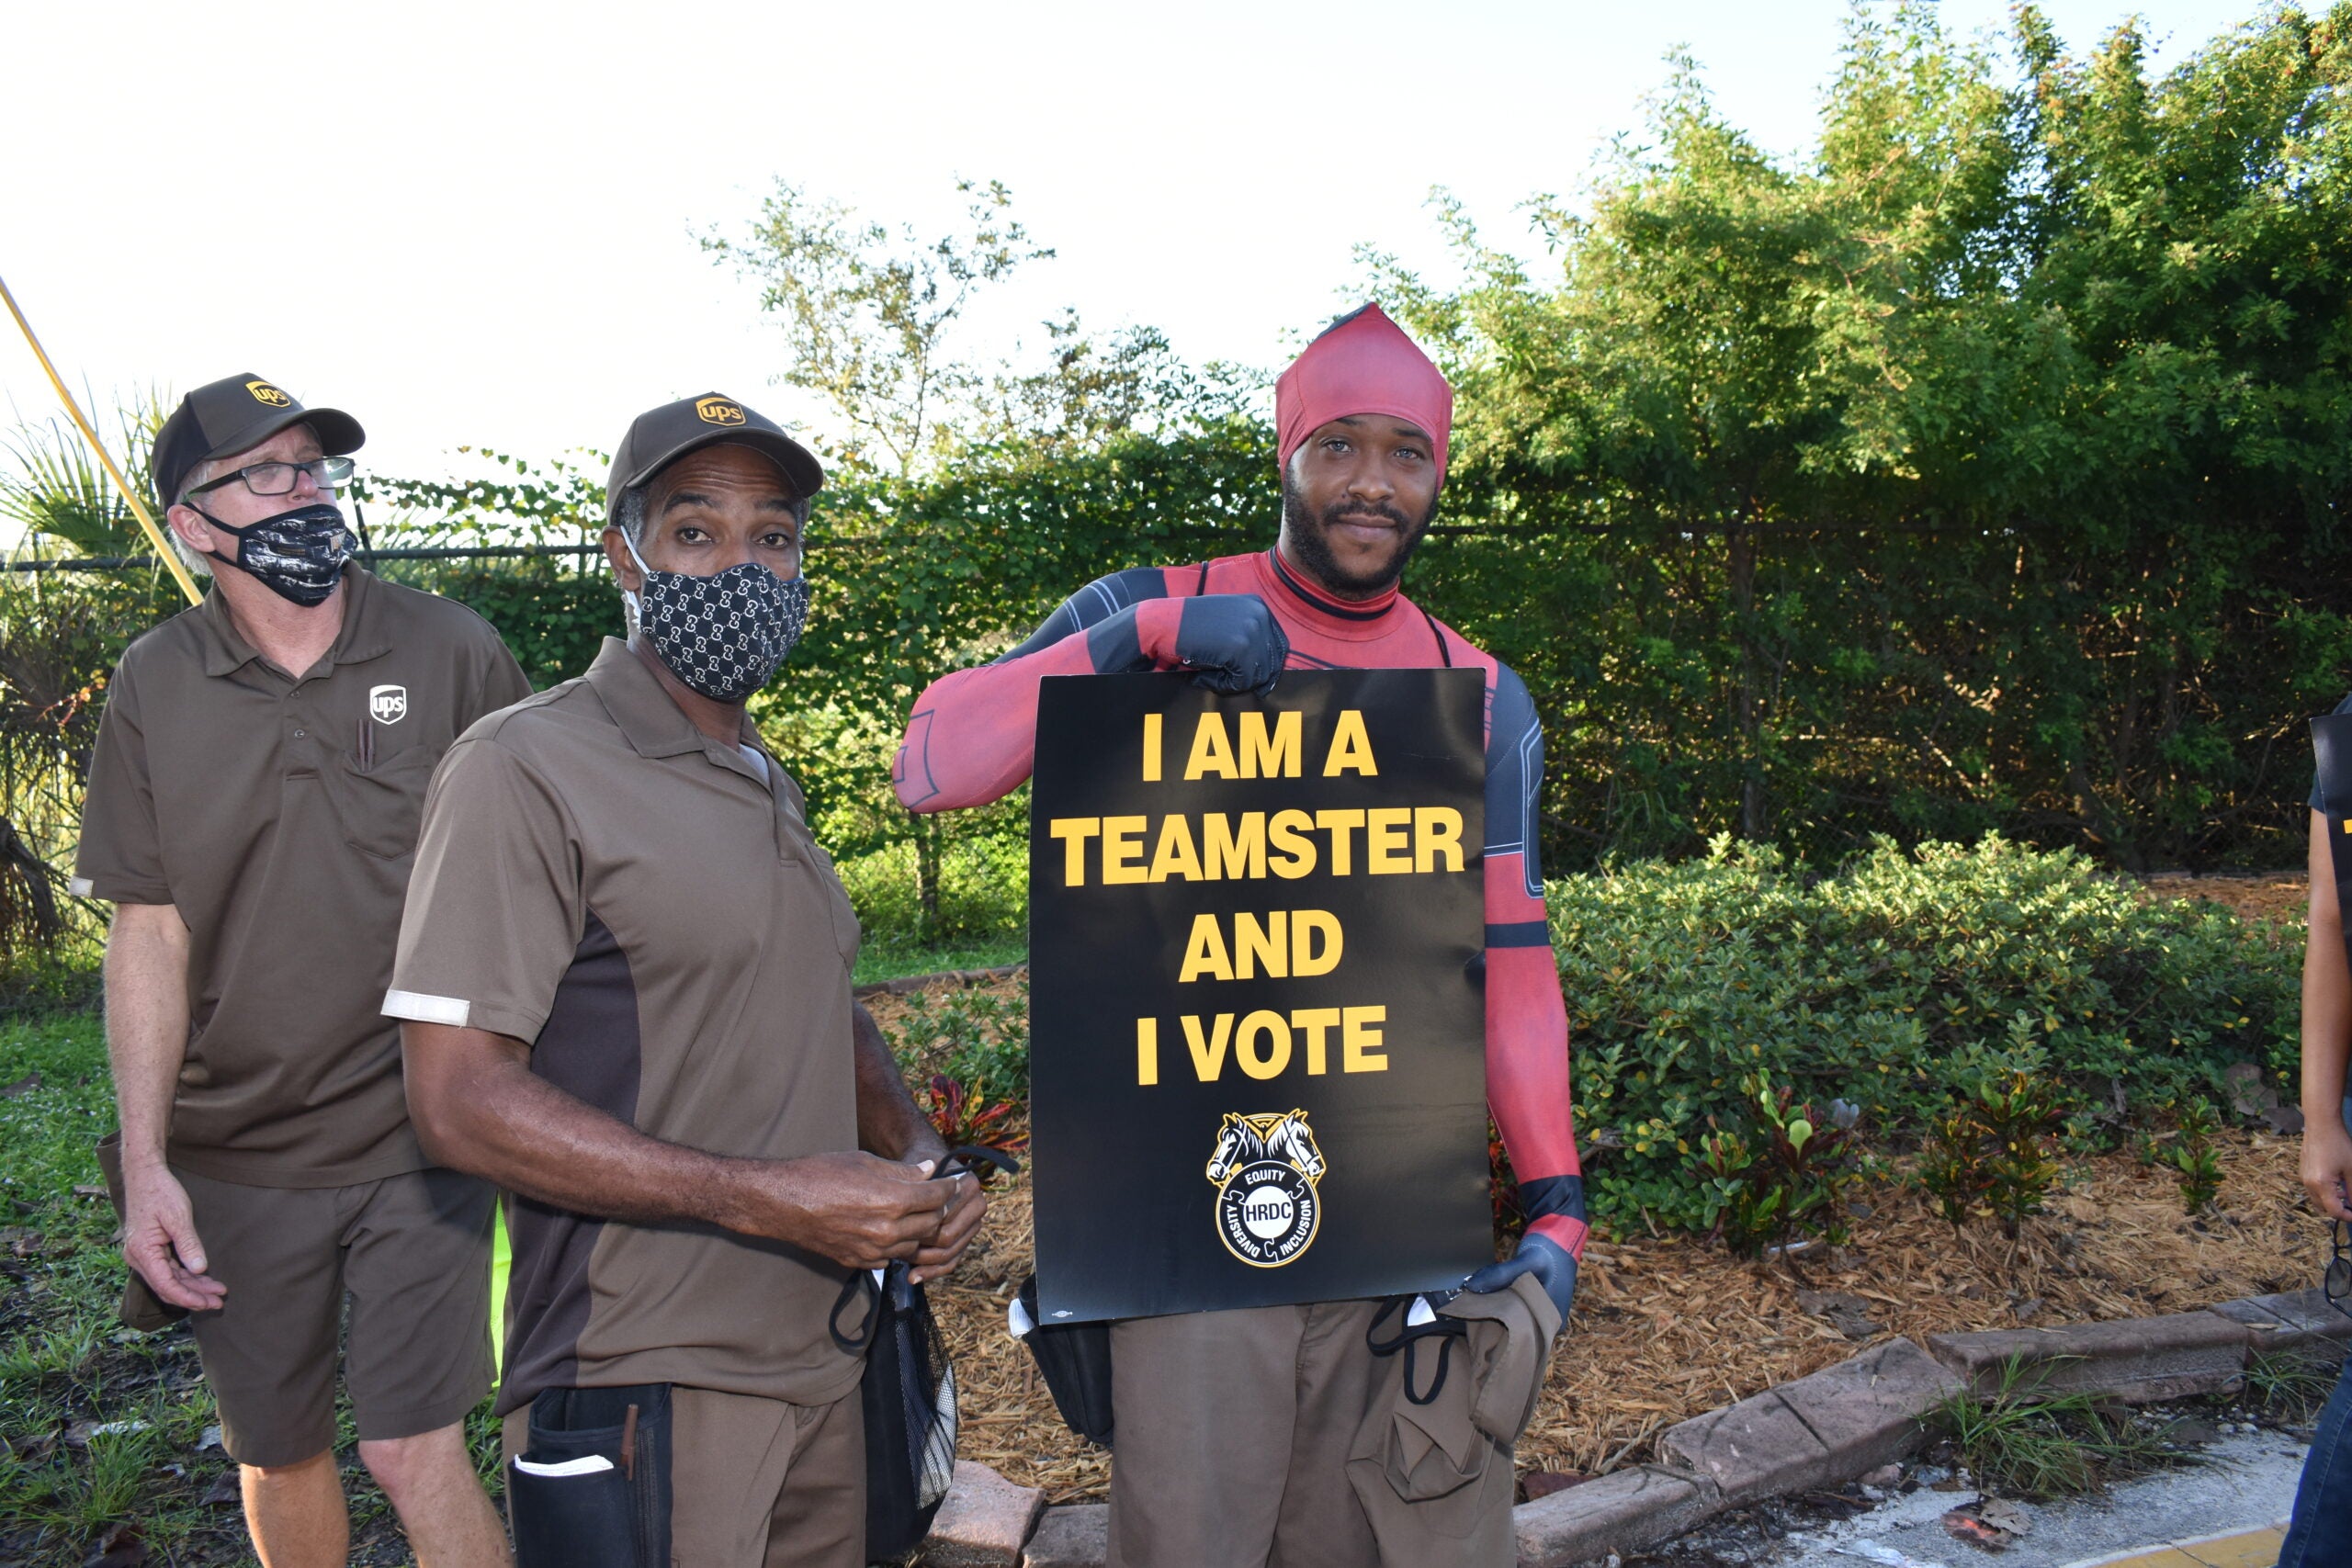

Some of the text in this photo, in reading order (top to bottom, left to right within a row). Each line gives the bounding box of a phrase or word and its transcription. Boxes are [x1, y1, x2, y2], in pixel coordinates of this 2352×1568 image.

[254, 388, 287, 403] ups
[701, 405, 742, 422] ups
[372, 696, 404, 718] ups
[1143, 710, 1378, 782] I AM A
[1050, 807, 1465, 887] TEAMSTER
[1178, 909, 1343, 983] AND
[1137, 1005, 1388, 1086] I VOTE
[1244, 1168, 1286, 1185] EQUITY
[1227, 1204, 1261, 1258] DIVERSITY
[1246, 1201, 1292, 1222] HRDC
[1279, 1199, 1312, 1256] INCLUSION
